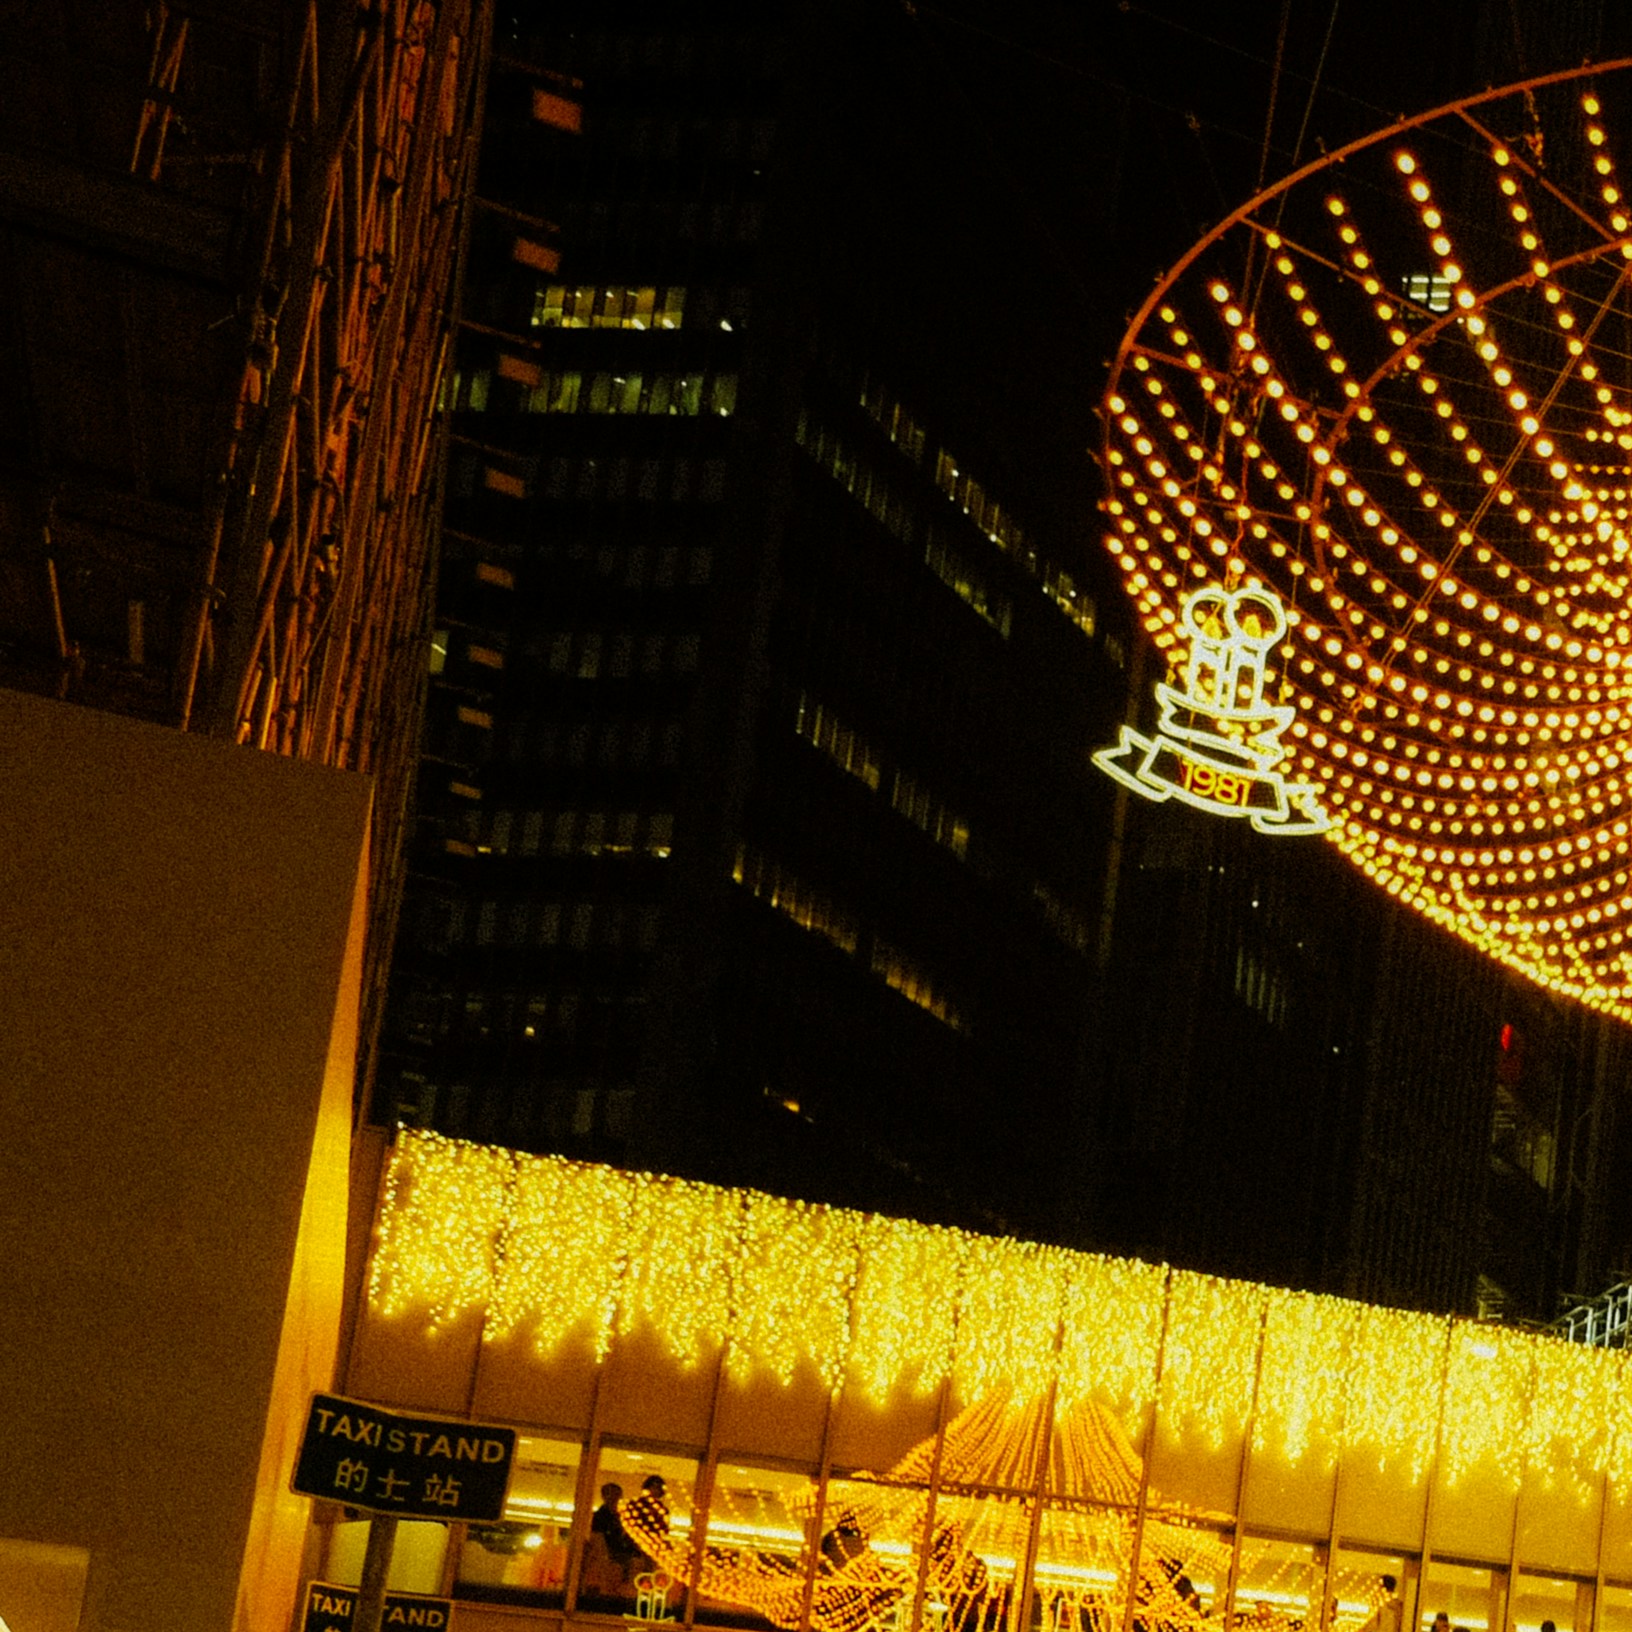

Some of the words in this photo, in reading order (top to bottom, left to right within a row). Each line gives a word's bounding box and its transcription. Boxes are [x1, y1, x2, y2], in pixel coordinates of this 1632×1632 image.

[1182, 758, 1250, 807] 1981
[317, 1408, 383, 1447] TAXI
[385, 1429, 505, 1464] STAND
[334, 1457, 462, 1507] 的士站
[312, 1593, 351, 1617] TAXI
